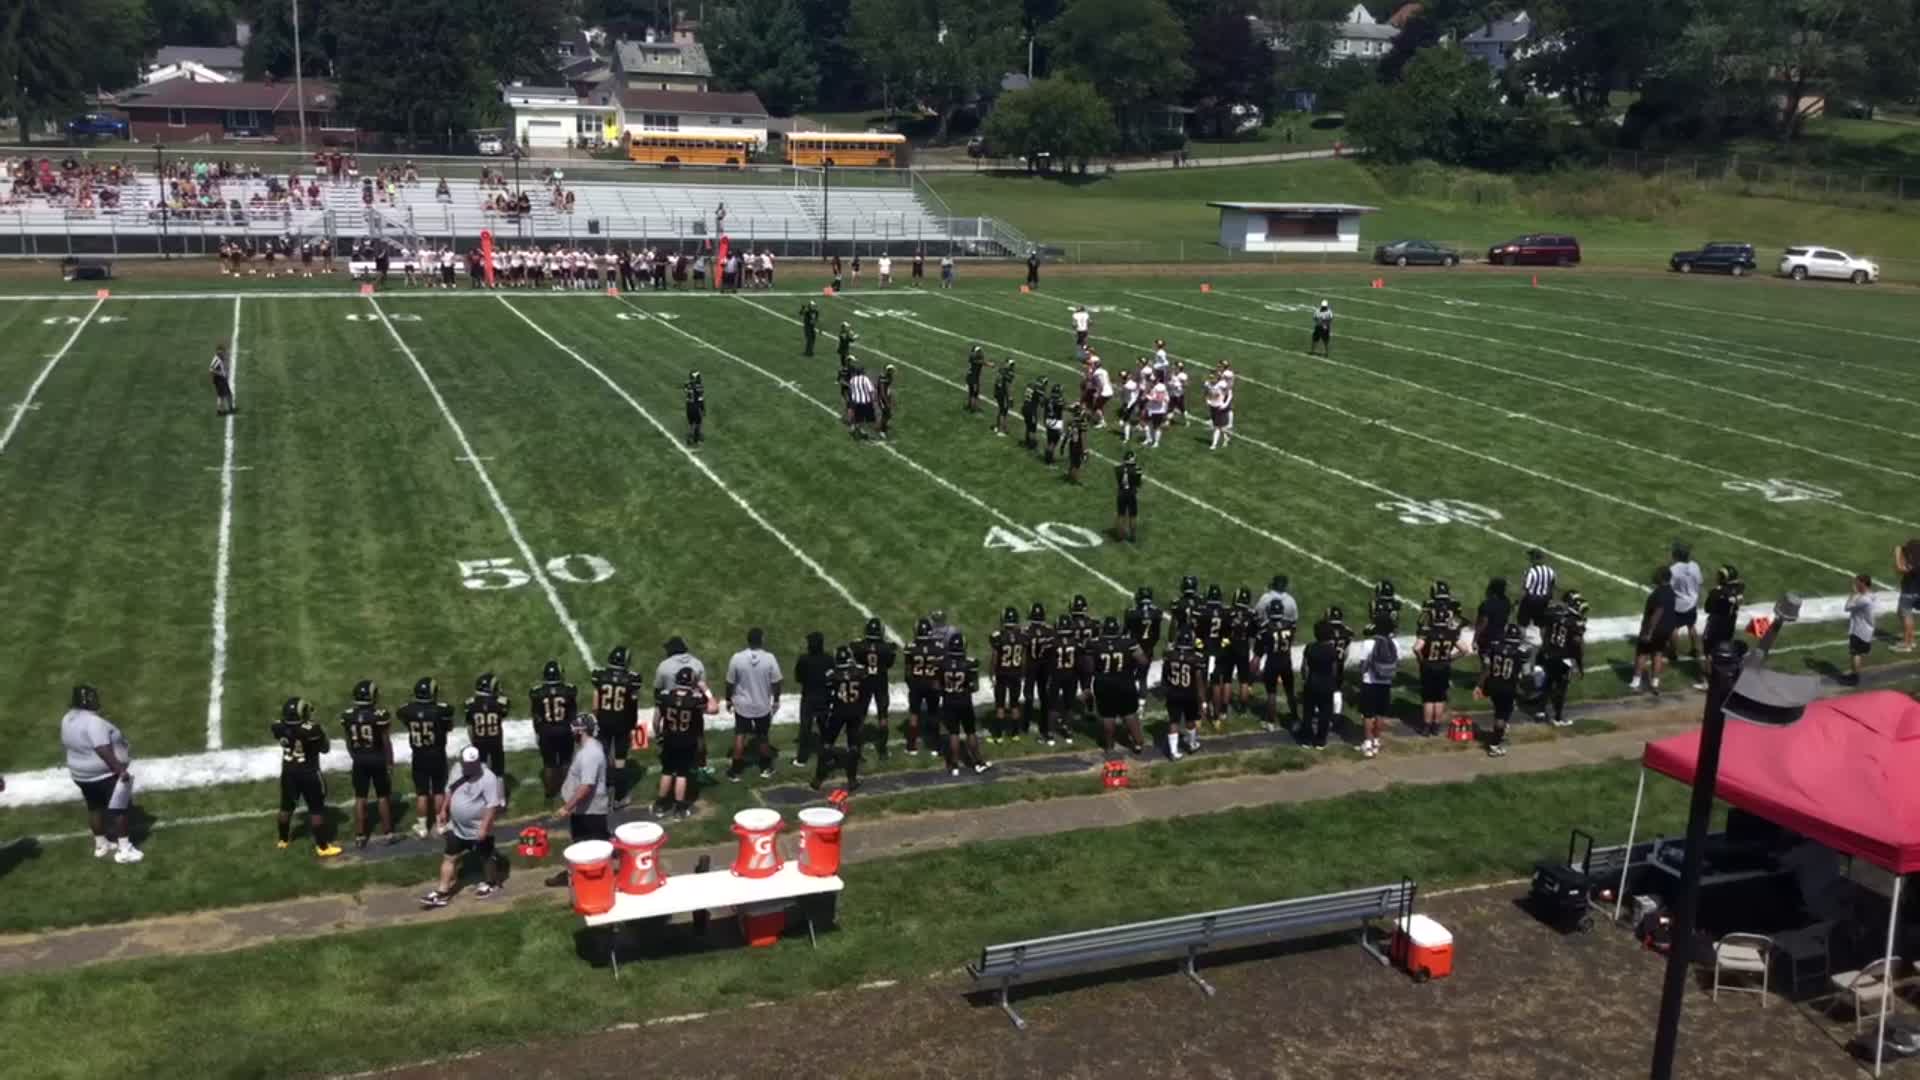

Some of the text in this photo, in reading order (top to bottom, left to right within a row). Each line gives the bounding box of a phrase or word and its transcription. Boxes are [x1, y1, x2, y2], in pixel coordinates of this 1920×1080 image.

[984, 521, 1104, 553] 40
[456, 553, 616, 590] 50
[1140, 620, 1151, 639] 7
[1209, 617, 1222, 638] 2
[1056, 647, 1075, 669] 13
[1100, 652, 1123, 673] 77
[601, 682, 627, 712] 26
[543, 696, 567, 722] 16
[755, 836, 772, 855] G
[635, 851, 653, 871] G
